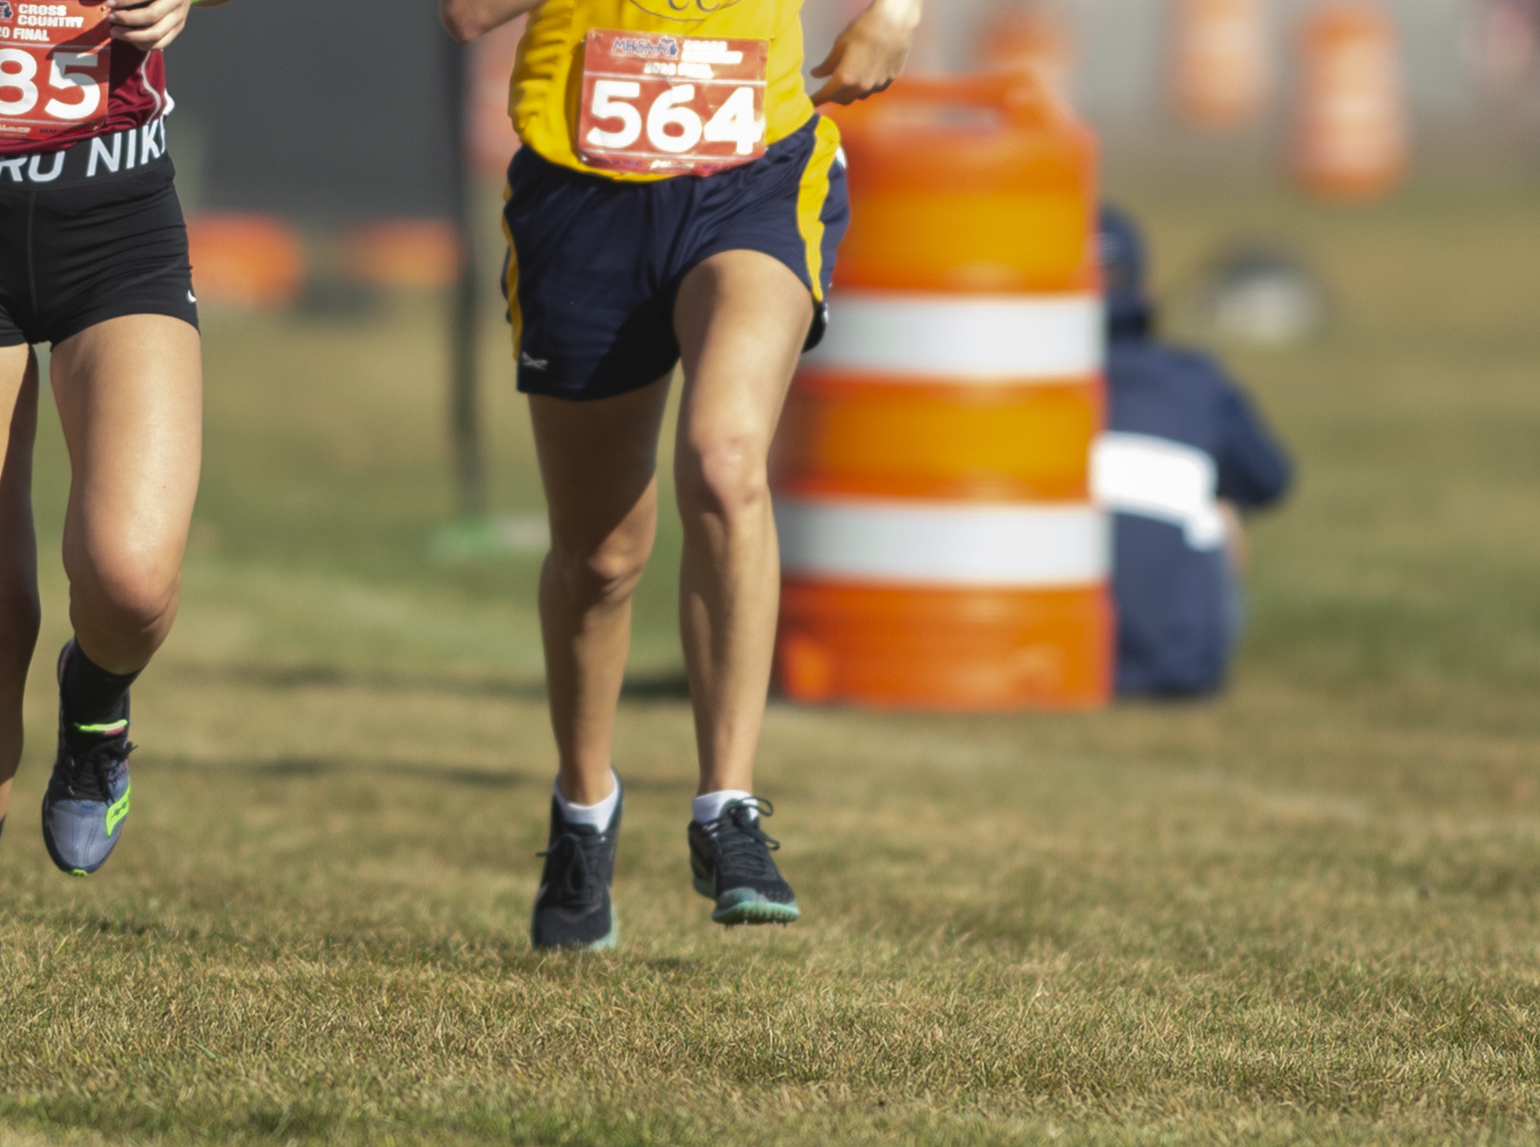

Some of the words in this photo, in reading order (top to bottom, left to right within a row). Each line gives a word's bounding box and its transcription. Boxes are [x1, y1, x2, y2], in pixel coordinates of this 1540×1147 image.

[18, 3, 68, 17] CROSS
[17, 14, 85, 28] COUNTRY
[12, 27, 51, 42] FINAL
[586, 79, 766, 156] 564
[86, 114, 166, 178] NIK
